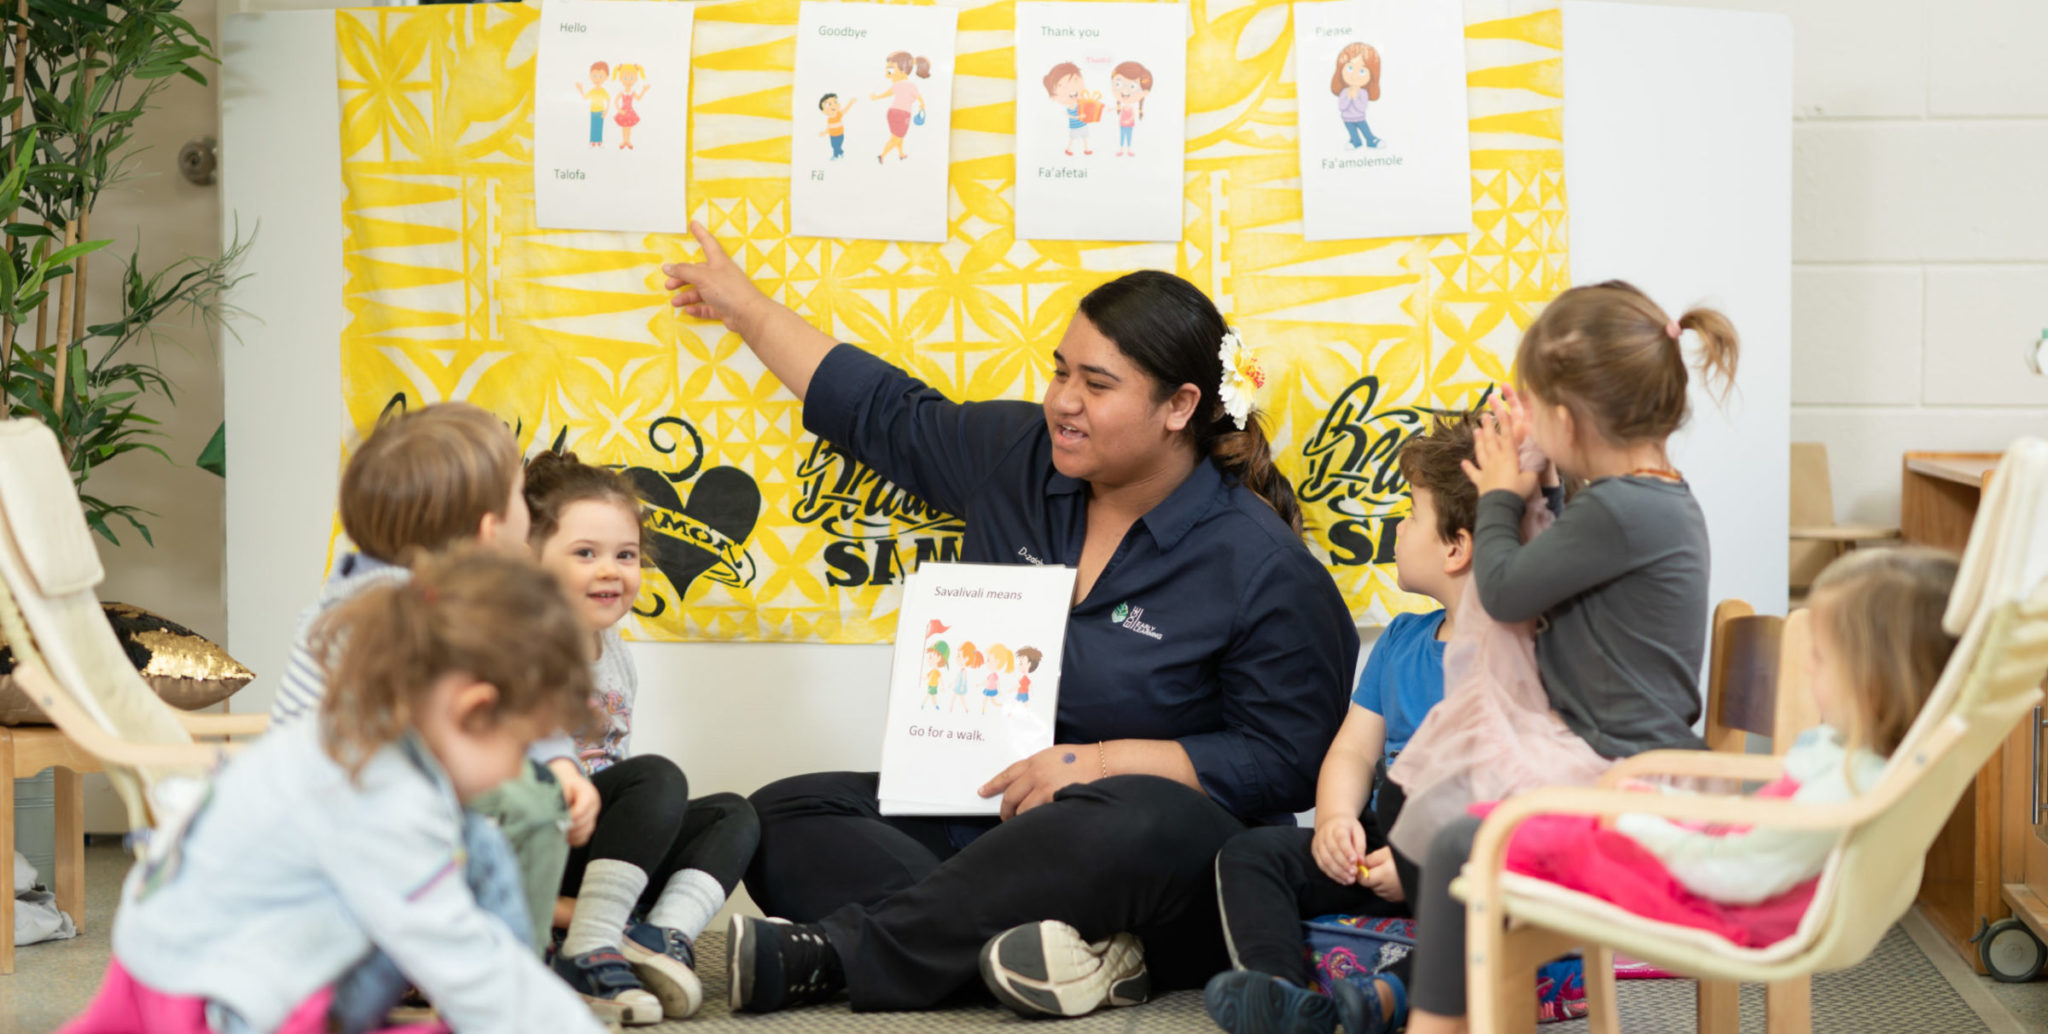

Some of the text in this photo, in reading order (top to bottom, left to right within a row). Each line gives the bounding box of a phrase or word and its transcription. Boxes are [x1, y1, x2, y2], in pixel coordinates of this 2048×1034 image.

[559, 22, 588, 34] Hello
[818, 25, 868, 39] Goodbye
[1040, 25, 1101, 39] Thank you
[1315, 26, 1353, 37] Please
[553, 168, 587, 181] Talofa
[933, 585, 1023, 601] Savalivali means
[908, 724, 986, 742] Go for a walk.
